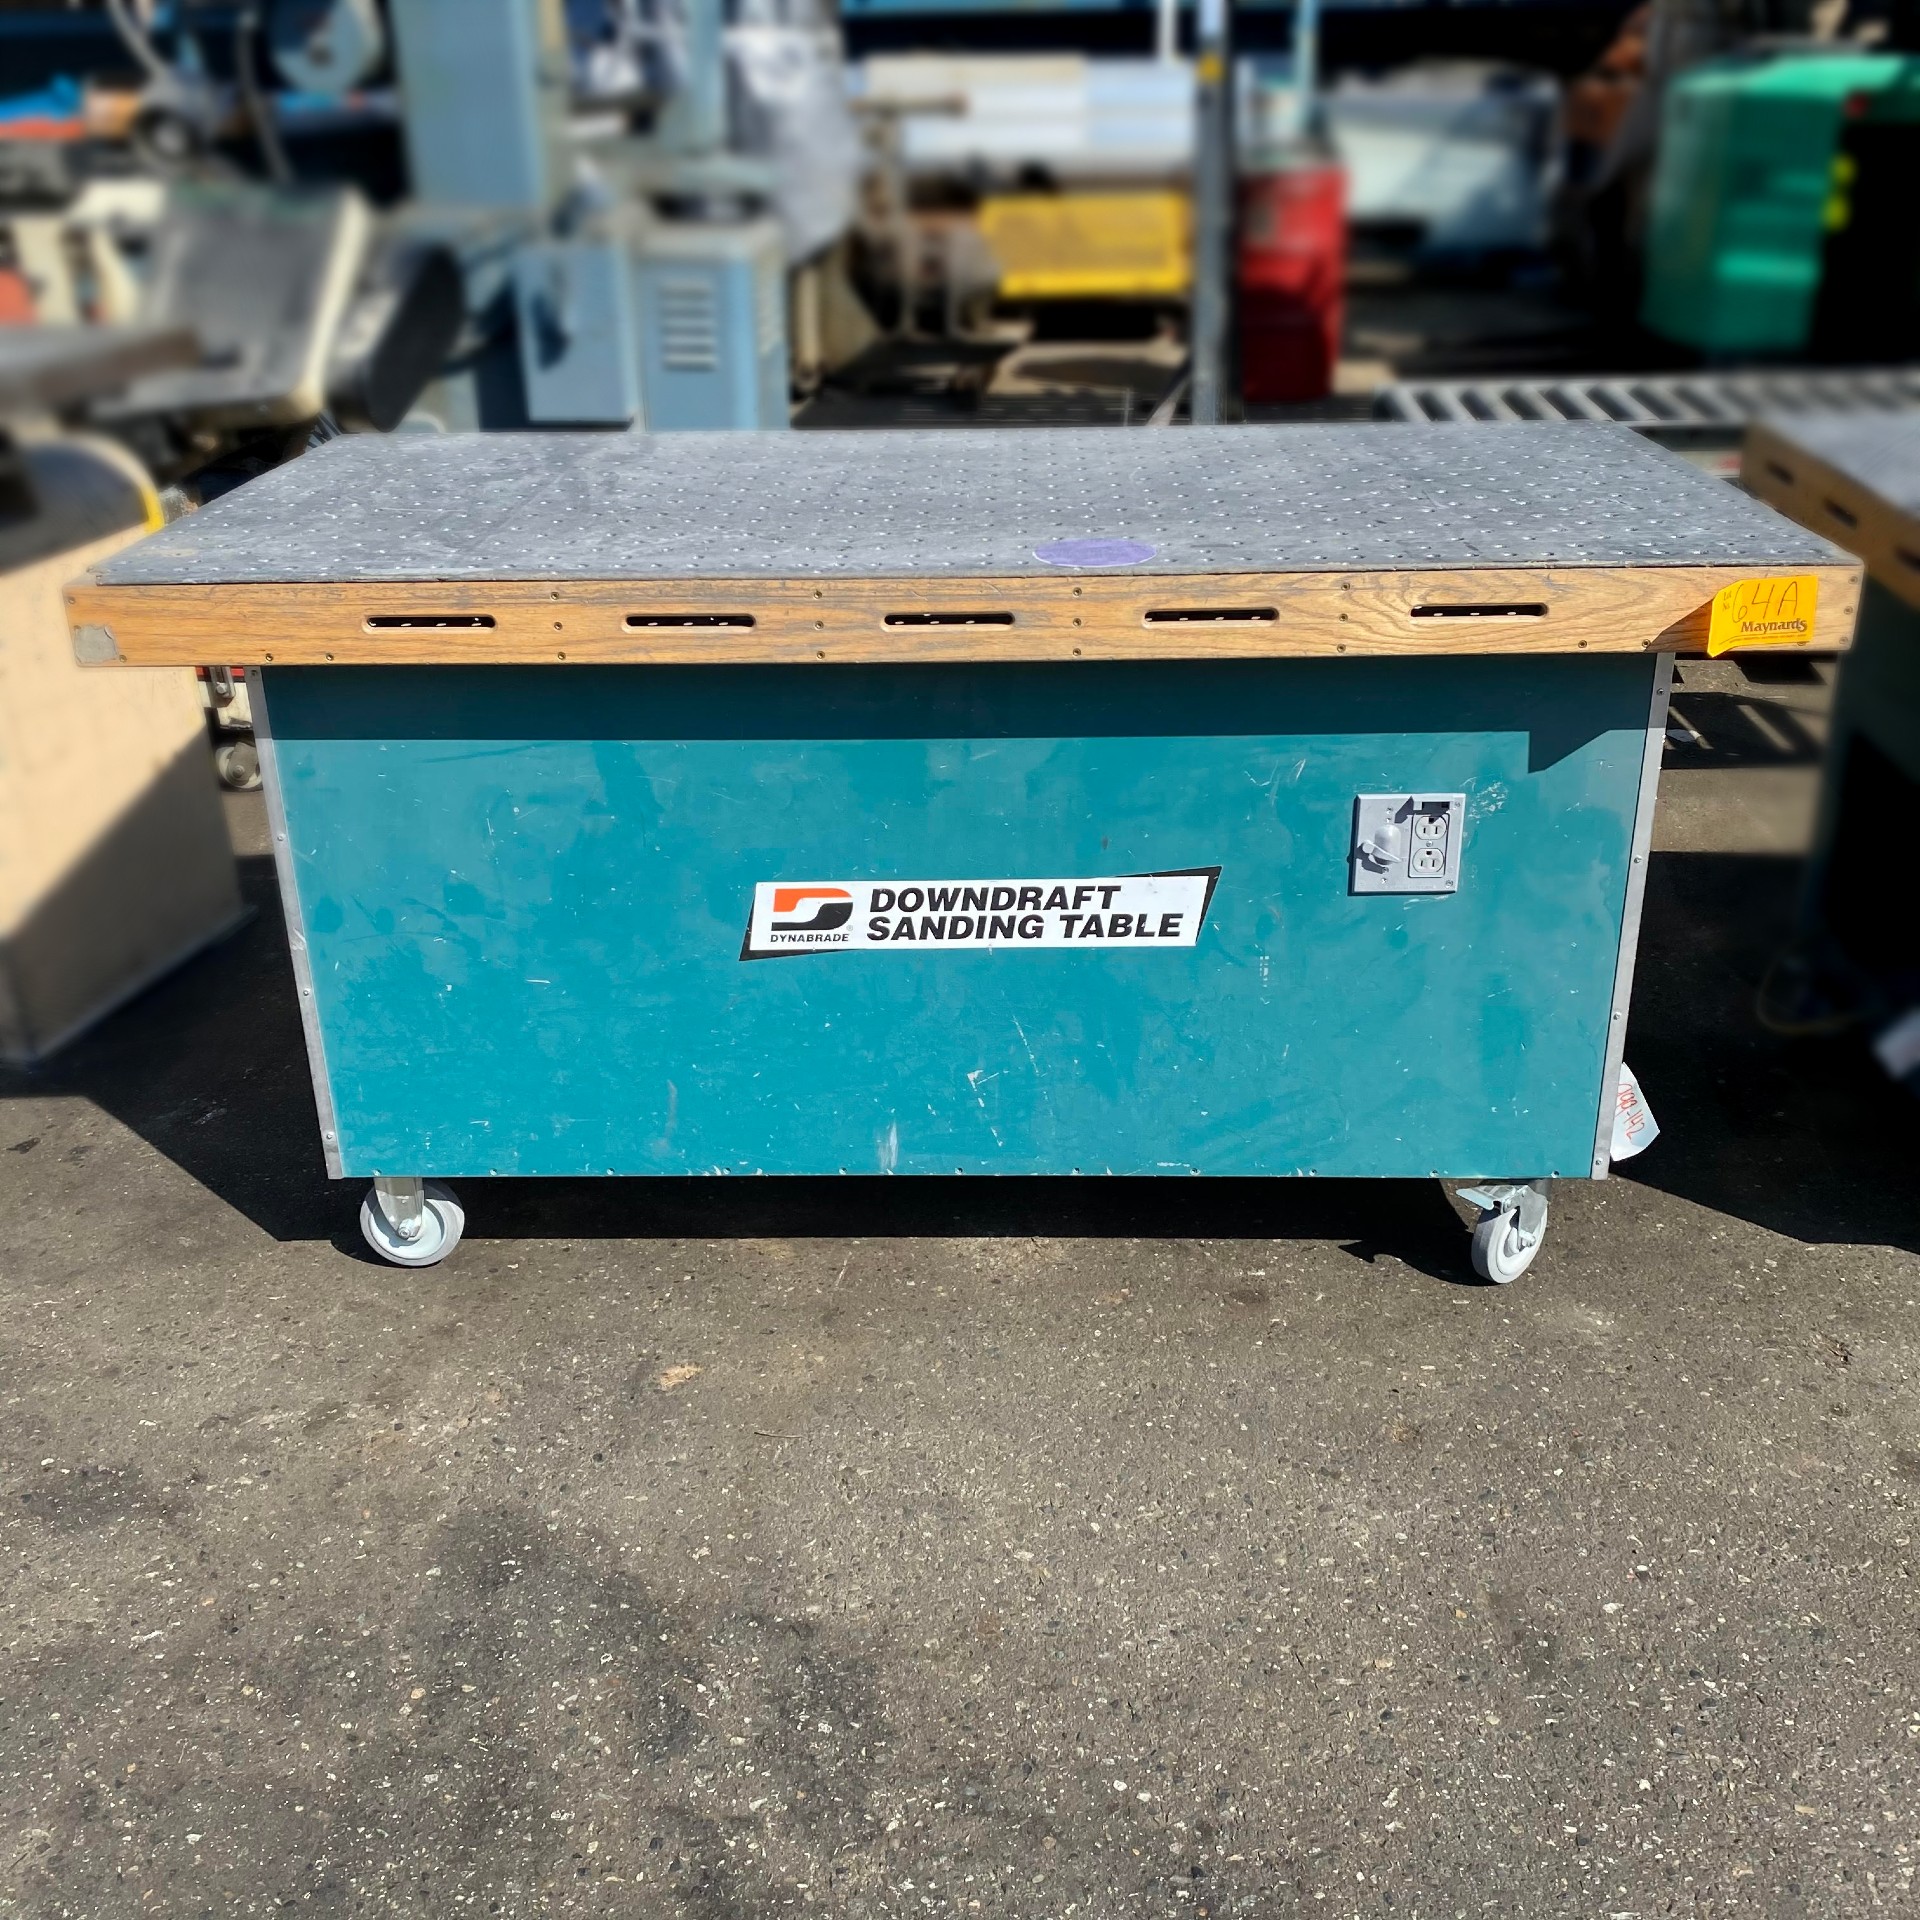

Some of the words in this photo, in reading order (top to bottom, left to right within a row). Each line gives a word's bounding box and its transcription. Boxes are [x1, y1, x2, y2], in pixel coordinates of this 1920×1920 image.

[1731, 580, 1798, 624] 64A
[1740, 617, 1808, 634] Maynards
[870, 886, 1122, 912] DOWNDRAFT
[770, 933, 850, 943] DYNABRADE
[866, 914, 1045, 941] SANDING
[1059, 913, 1184, 939] TABLE
